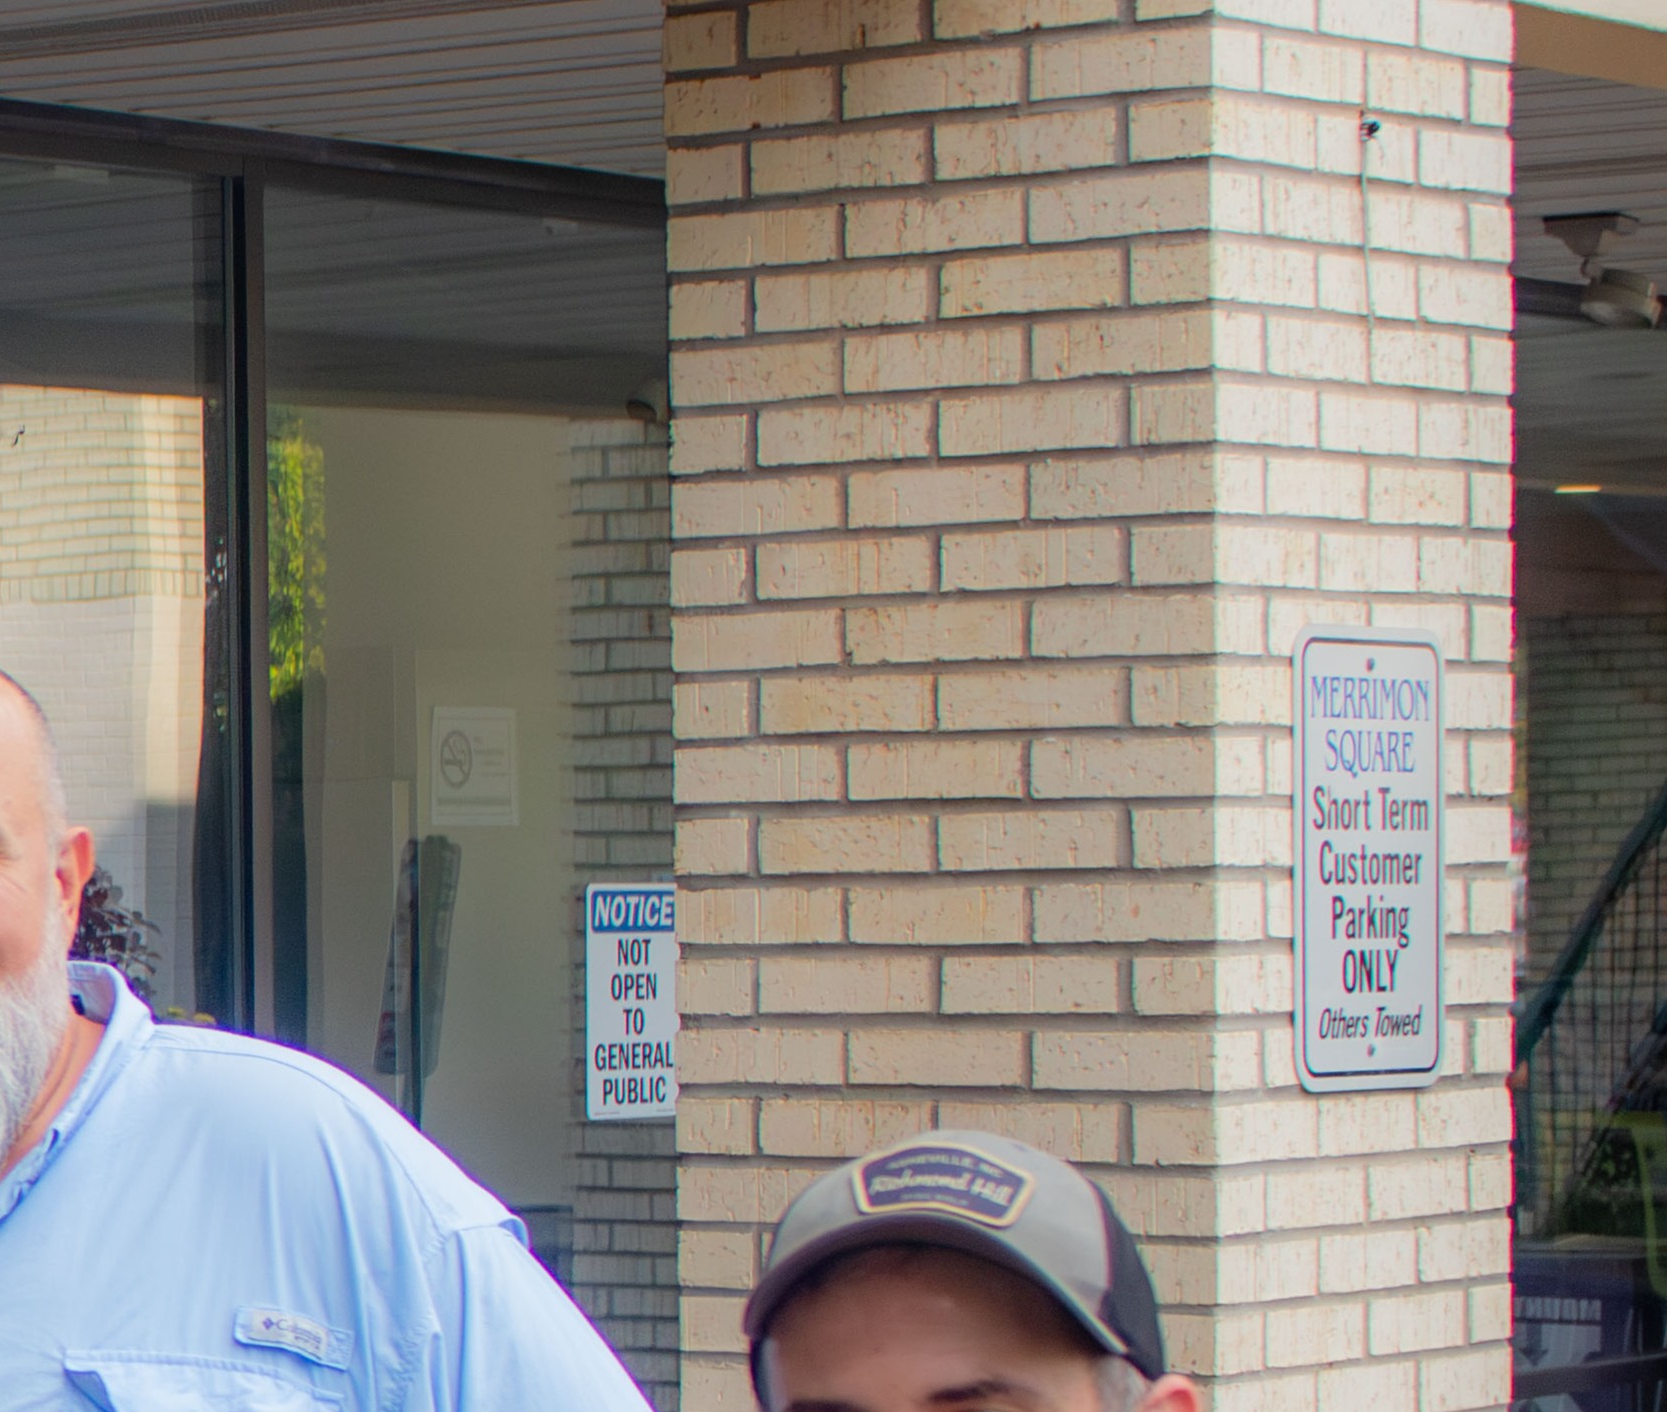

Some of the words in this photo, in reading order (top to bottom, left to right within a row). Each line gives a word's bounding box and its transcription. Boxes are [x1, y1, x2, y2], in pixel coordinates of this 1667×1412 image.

[1310, 675, 1431, 722] MERRIMON
[1325, 729, 1414, 777] SQUARE
[1312, 785, 1371, 832] Short
[1378, 787, 1430, 832] Term
[1319, 840, 1423, 886] Customer
[594, 894, 674, 928] NOTICE
[1331, 895, 1410, 948] Parking
[617, 939, 651, 967] NOT
[610, 973, 657, 1001] OPEN
[1342, 950, 1400, 994] ONLY
[622, 1008, 645, 1036] TO
[1319, 1007, 1369, 1041] Others
[1374, 1004, 1423, 1038] Towed
[594, 1041, 674, 1071] GENERAL
[602, 1076, 666, 1106] PUBLIC
